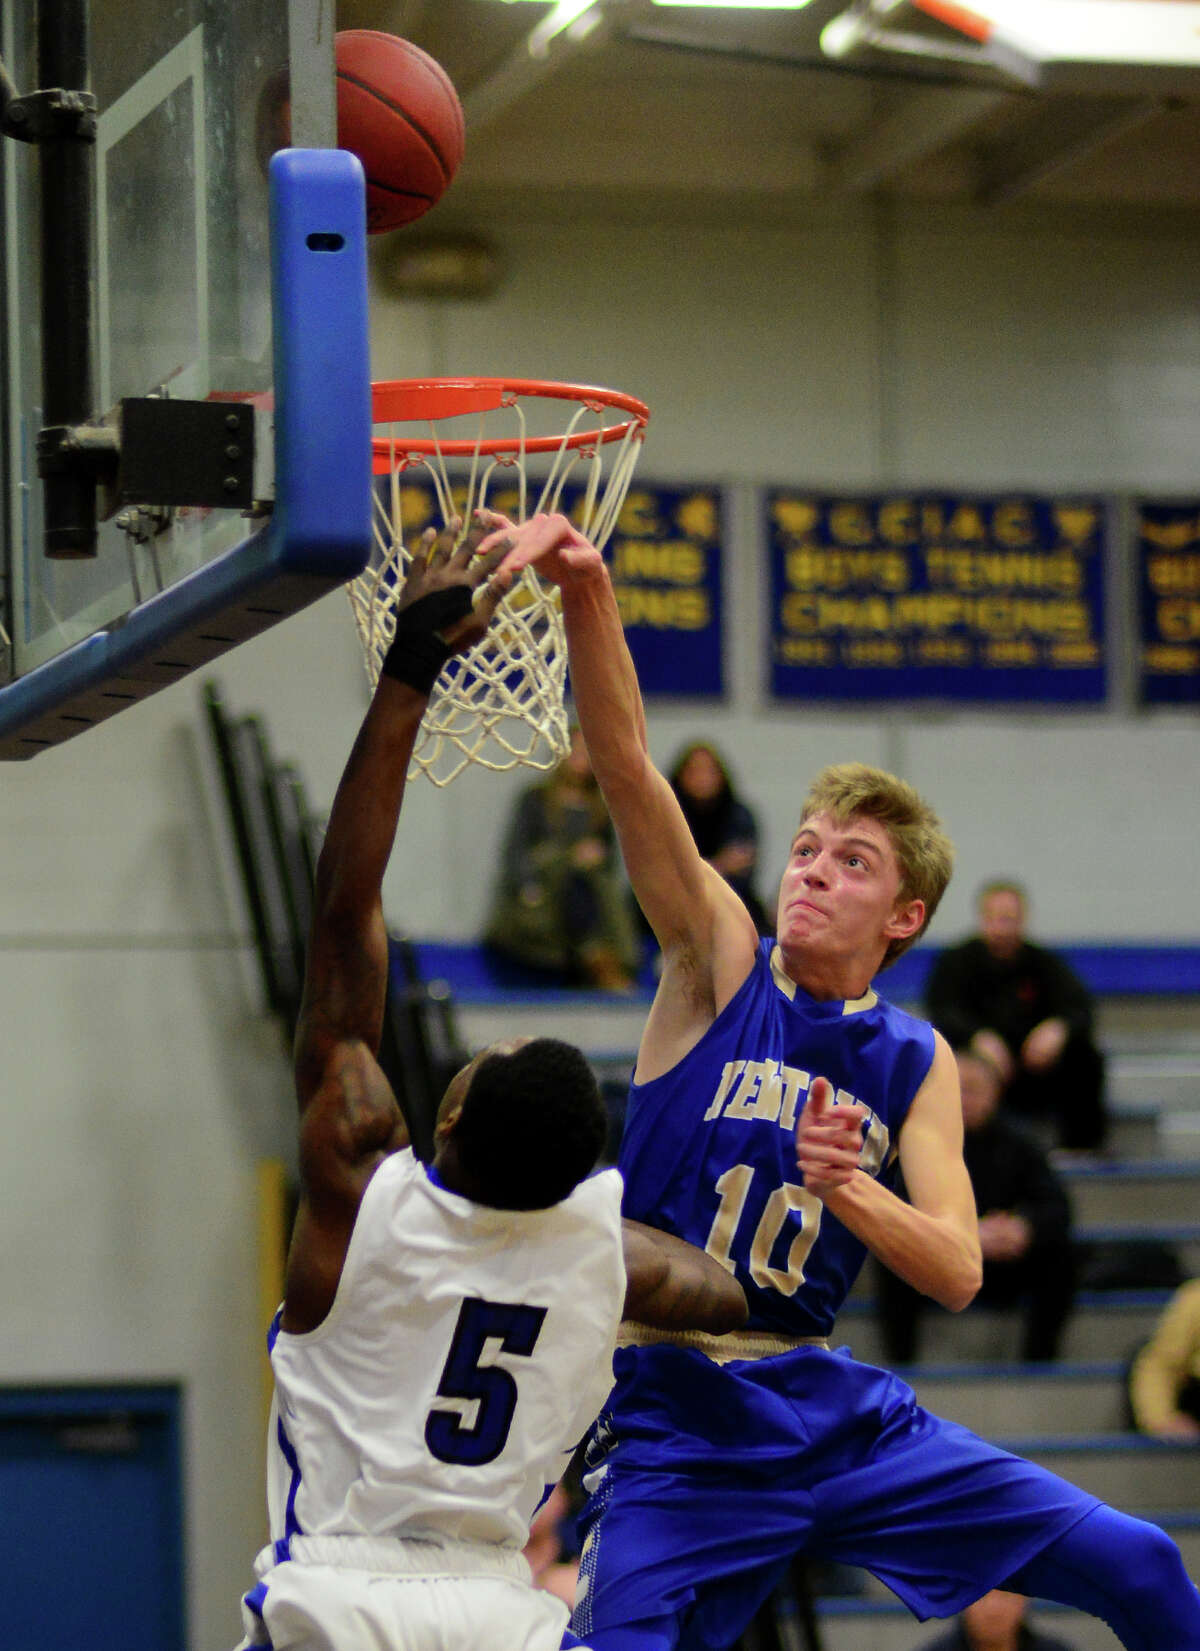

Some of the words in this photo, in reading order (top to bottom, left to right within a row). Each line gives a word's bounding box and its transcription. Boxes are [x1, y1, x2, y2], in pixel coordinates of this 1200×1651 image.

[783, 592, 1090, 638] CHAMPIONS
[705, 1164, 823, 1297] 10
[424, 1296, 549, 1467] 5
